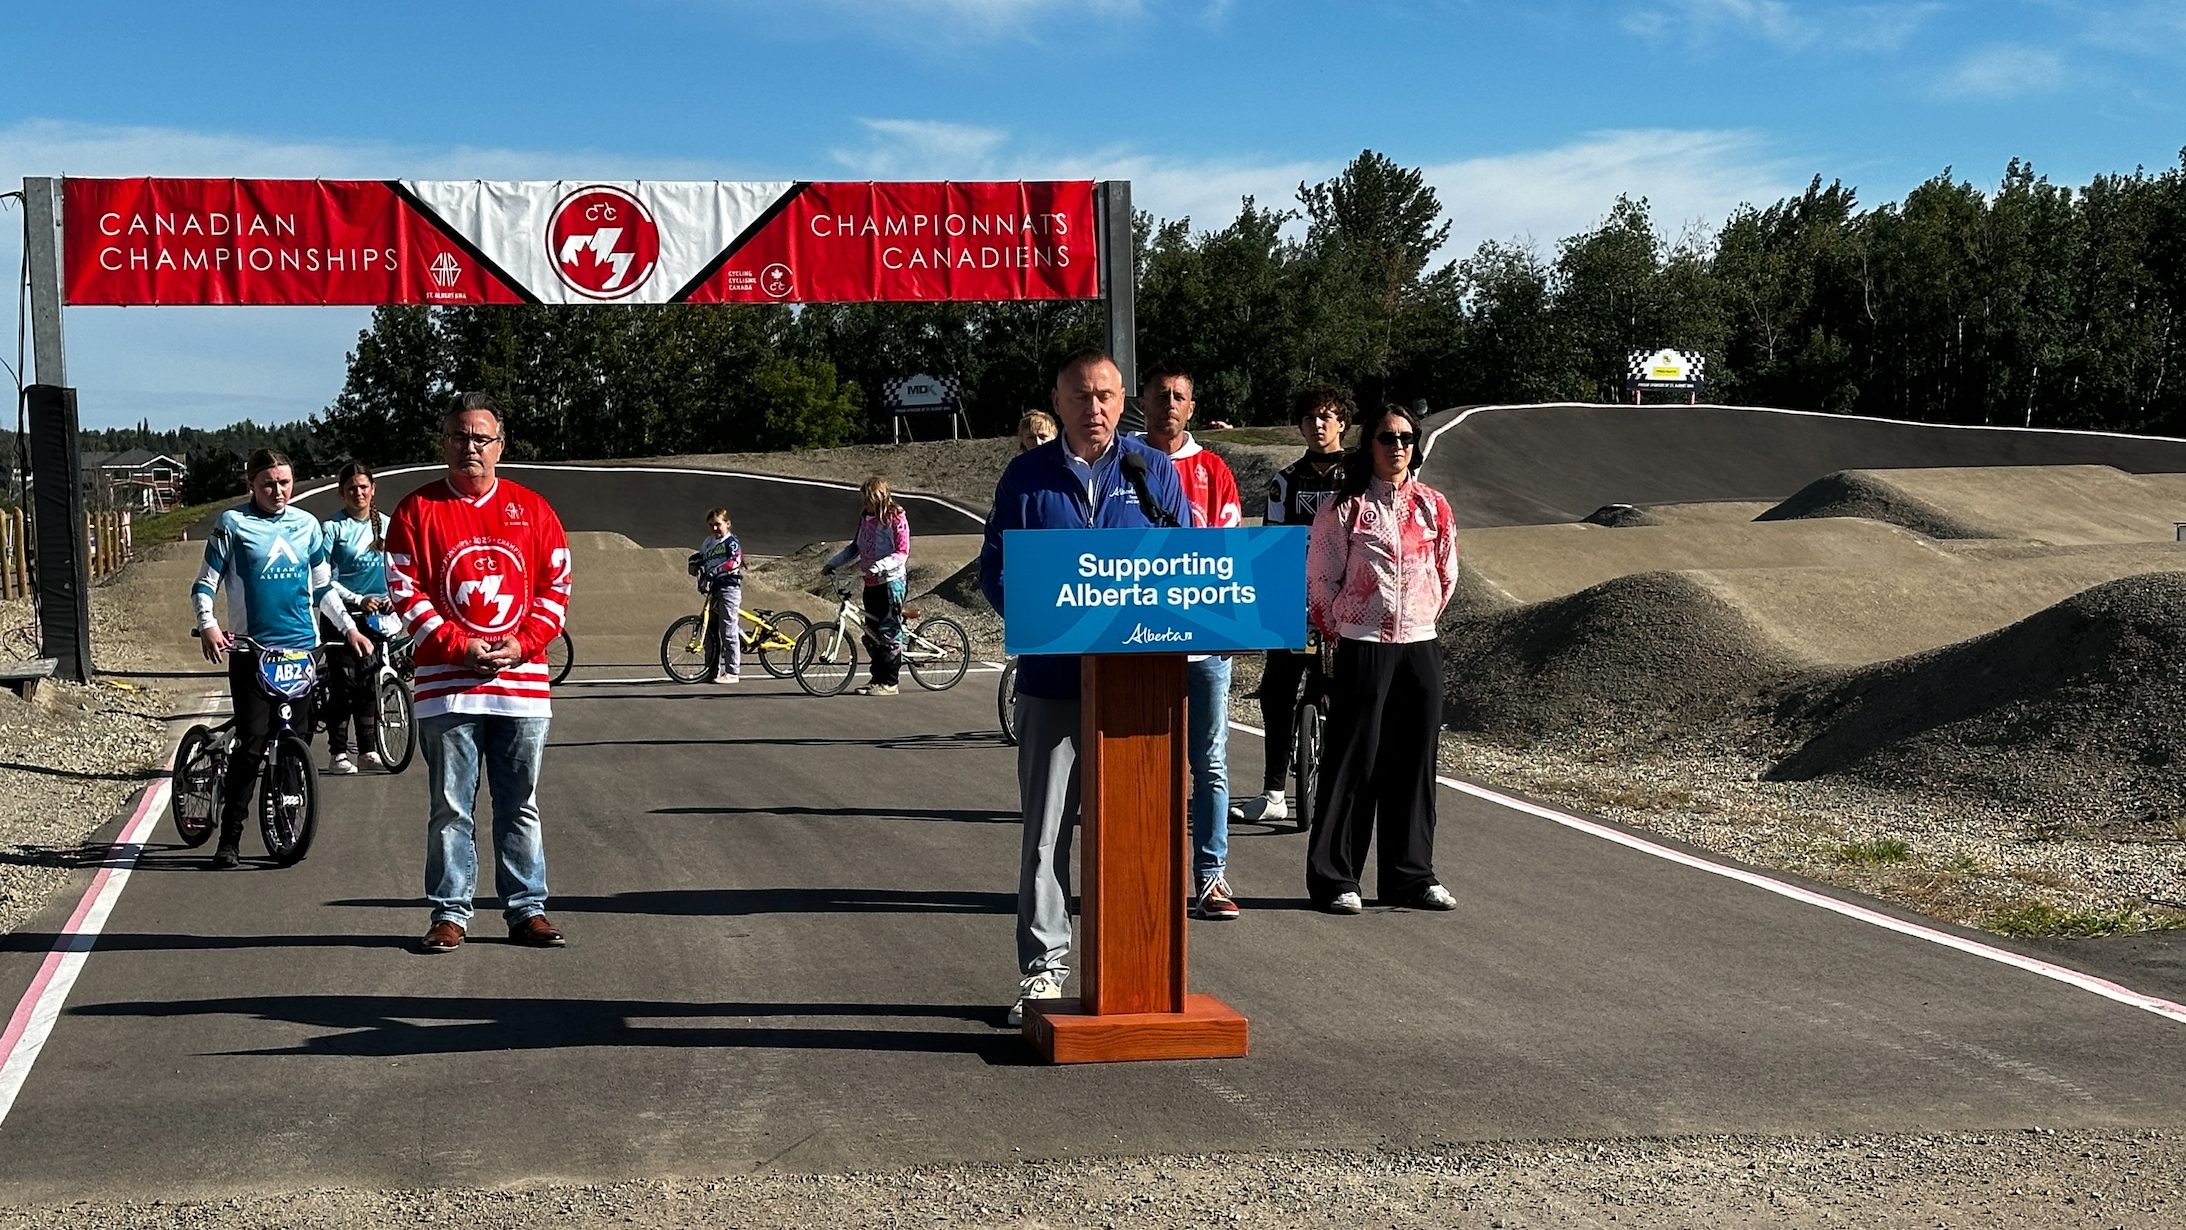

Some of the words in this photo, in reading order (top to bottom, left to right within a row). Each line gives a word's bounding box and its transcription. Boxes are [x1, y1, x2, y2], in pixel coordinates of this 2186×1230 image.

[99, 211, 296, 237] CANADIAN
[810, 212, 1069, 238] CHAMPIONNATS
[99, 246, 398, 272] CHAMPIONSHIPS
[882, 245, 1071, 270] CANADIENS
[1077, 551, 1234, 581] Supporting
[1055, 583, 1159, 607] Alberta
[1166, 581, 1257, 610] sports
[1121, 622, 1186, 645] Alberta
[274, 663, 303, 683] AB2
